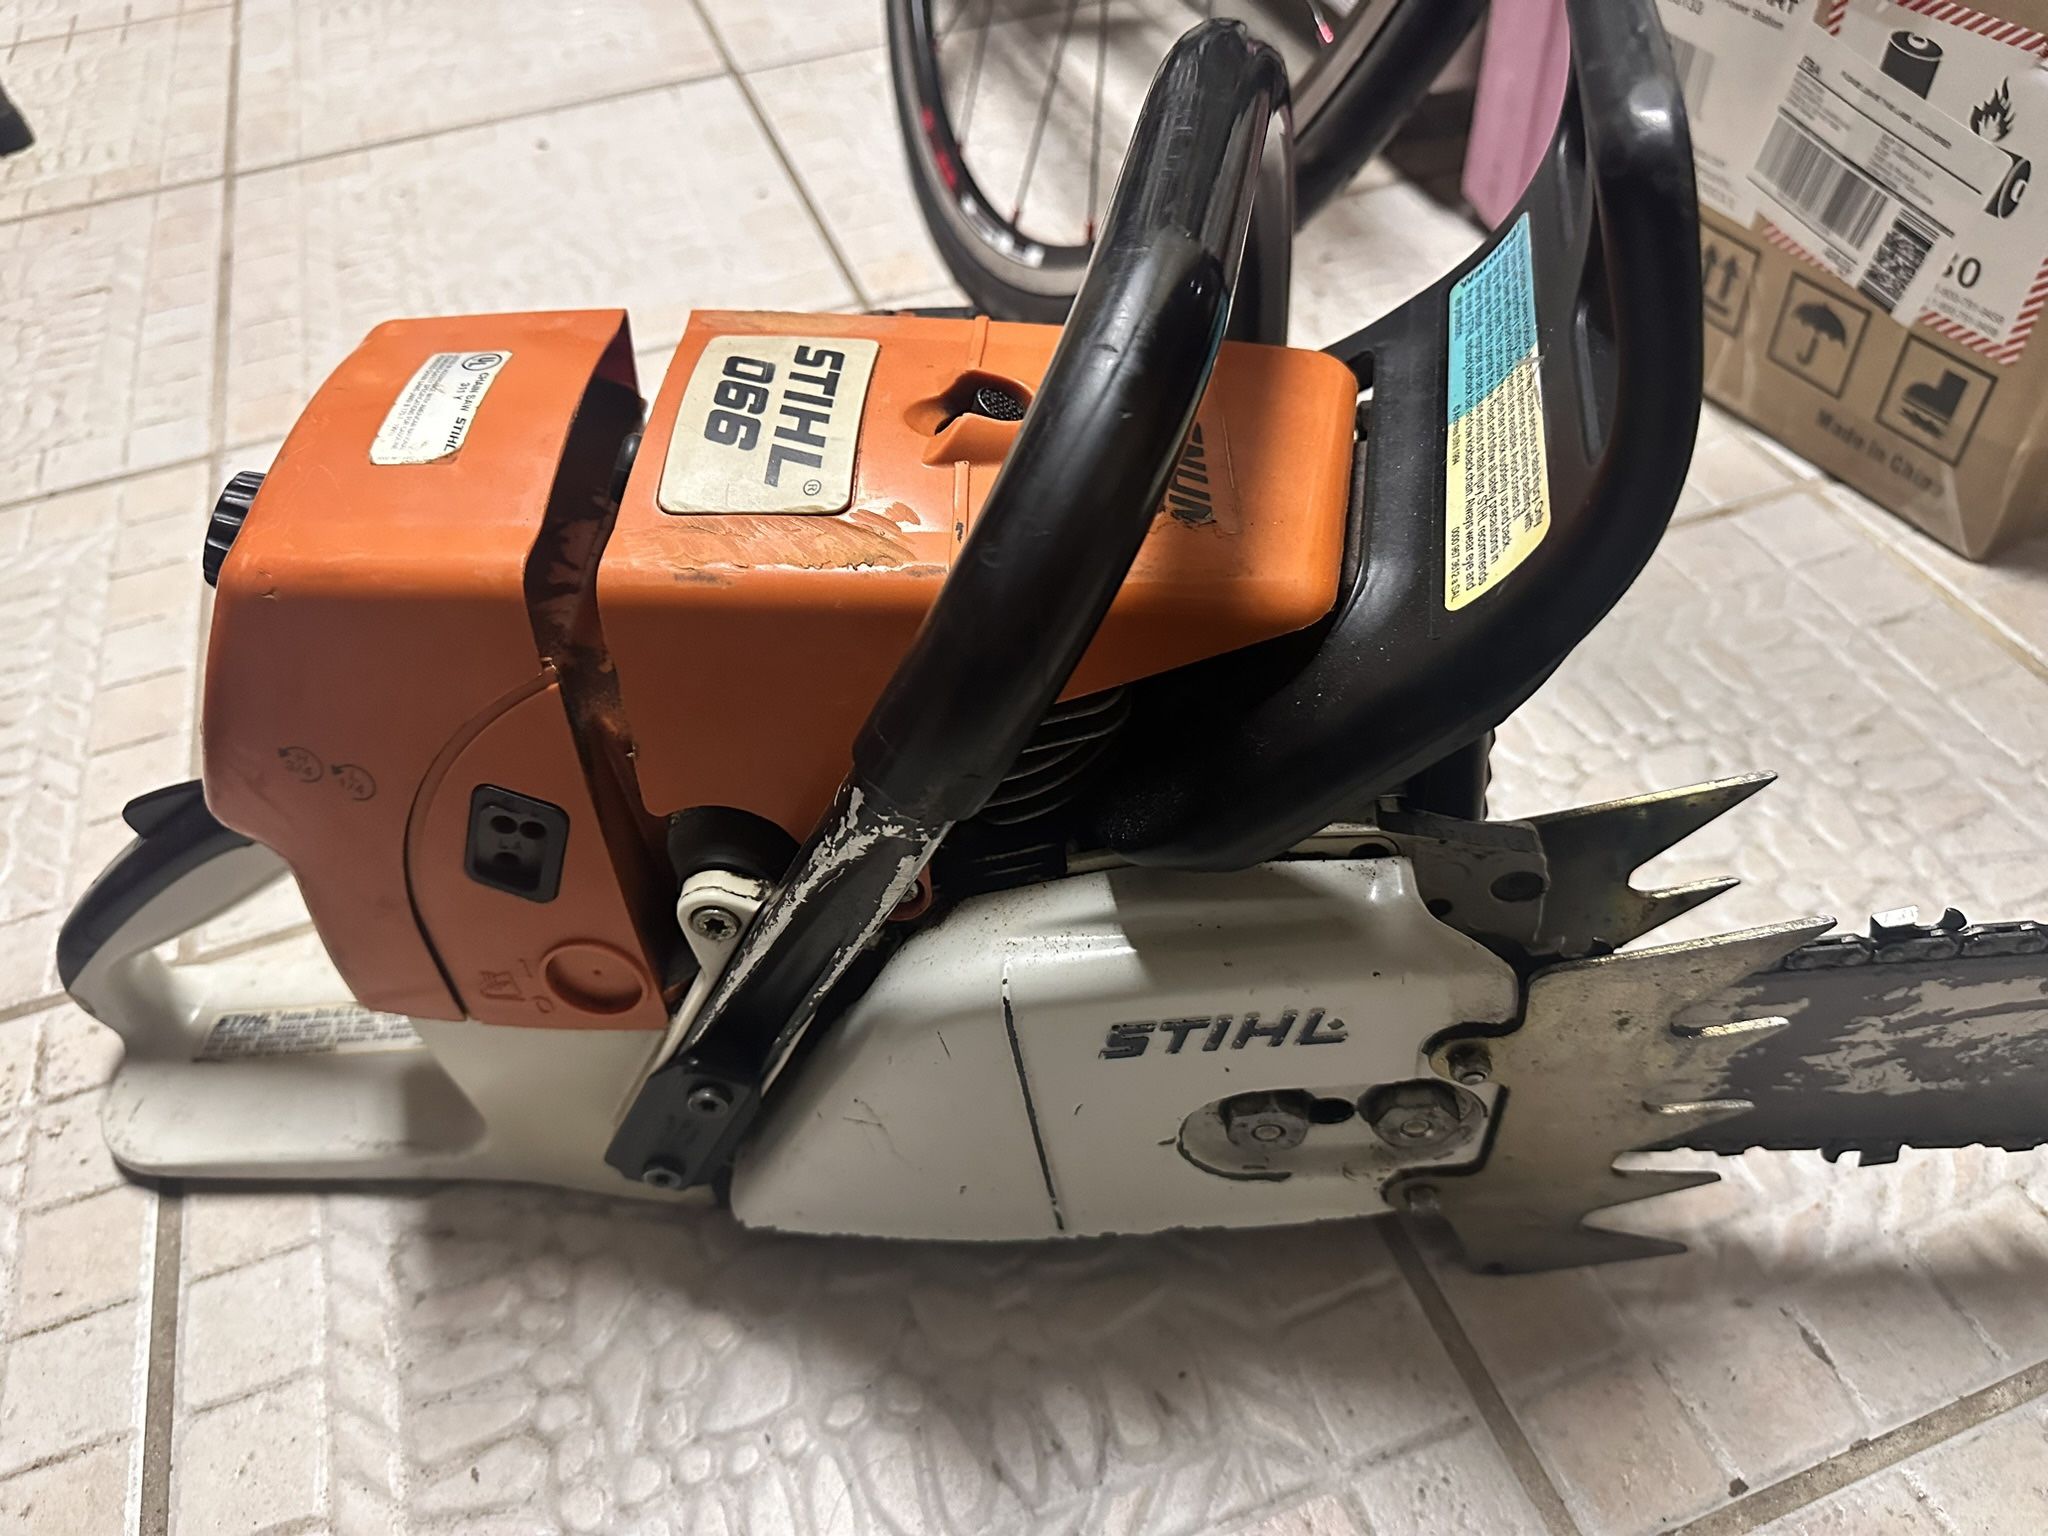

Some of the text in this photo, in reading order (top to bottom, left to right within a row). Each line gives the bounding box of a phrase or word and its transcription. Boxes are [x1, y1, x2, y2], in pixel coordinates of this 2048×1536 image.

[1466, 365, 1474, 397] kickback
[1496, 357, 1504, 381] cause
[444, 373, 489, 451] CHAIN SAW STIHL
[704, 355, 776, 452] 066
[764, 344, 845, 488] STIHL
[1475, 392, 1483, 415] cause
[1487, 398, 1498, 423] Read
[1464, 408, 1474, 425] and
[1476, 415, 1485, 443] serious
[1498, 412, 1506, 428] bar
[1465, 422, 1475, 439] low
[1488, 423, 1497, 440] and
[1498, 426, 1507, 438] to
[1520, 428, 1528, 446] and
[1465, 437, 1475, 472] kickback
[1477, 443, 1485, 453] or
[1488, 437, 1497, 463] follow
[1499, 435, 1508, 455] kick
[1477, 451, 1486, 472] fatal
[1488, 463, 1498, 475] all
[1496, 454, 1509, 493] suddenly
[1510, 451, 1520, 477] Avoid
[1518, 443, 1530, 479] training
[1465, 473, 1476, 499] chain.
[1485, 474, 1499, 501] safety
[1512, 476, 1521, 510] contact
[1476, 495, 1488, 526] STIHL
[1499, 493, 1509, 506] up
[1463, 498, 1476, 529] Always
[1501, 506, 1511, 525] and
[1451, 527, 1460, 545] 0000
[1488, 501, 1499, 553] precautions
[1502, 522, 1512, 552] back.
[1466, 529, 1474, 552] wear
[1462, 553, 1474, 571] eye
[1478, 526, 1488, 585] recommends
[1491, 550, 1501, 564] in
[1466, 571, 1476, 591] and
[1098, 1006, 1349, 1060] STIHL
